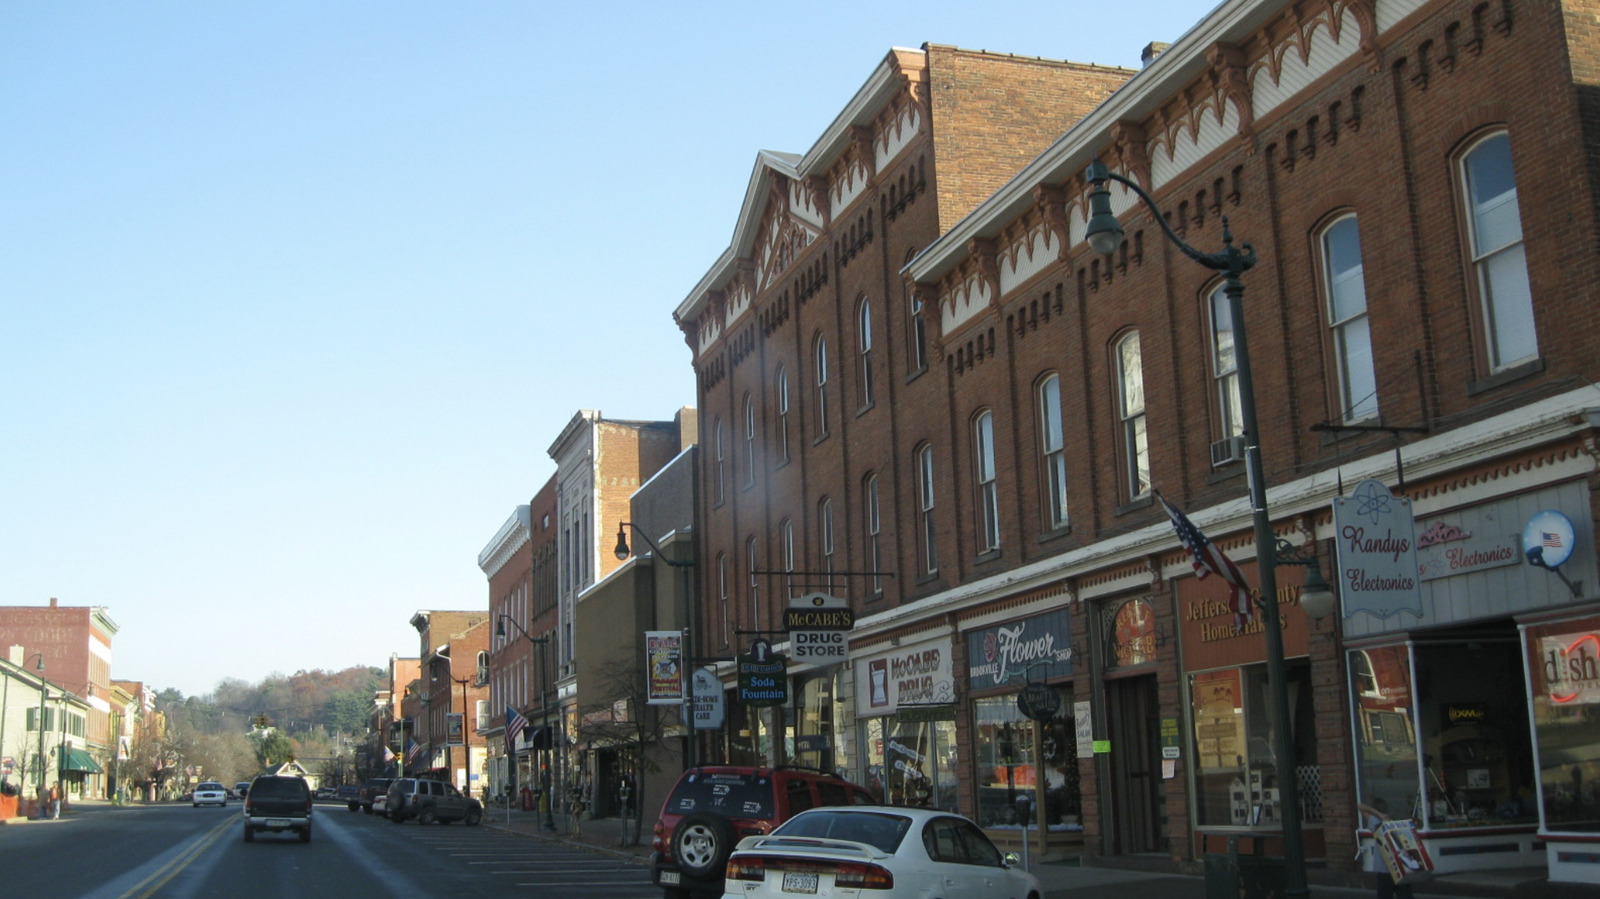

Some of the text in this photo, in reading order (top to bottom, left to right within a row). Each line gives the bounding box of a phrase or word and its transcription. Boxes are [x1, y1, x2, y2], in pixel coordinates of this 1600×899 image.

[1343, 526, 1410, 562] Randys
[1446, 545, 1513, 570] Electronics
[1347, 569, 1414, 592] Electronics
[1187, 582, 1299, 622] Jeffers Cnty
[788, 611, 851, 626] McCABE'S
[796, 633, 843, 644] DRUG
[796, 646, 845, 657] STORE
[994, 622, 1057, 684] Flower
[1056, 648, 1072, 661] SHOP
[970, 662, 999, 678] BROOKVILLE
[1545, 647, 1598, 683] dish
[751, 677, 775, 687] Soda
[898, 676, 934, 702] DRUG
[742, 688, 784, 699] Fountain
[696, 712, 711, 720] CARE
